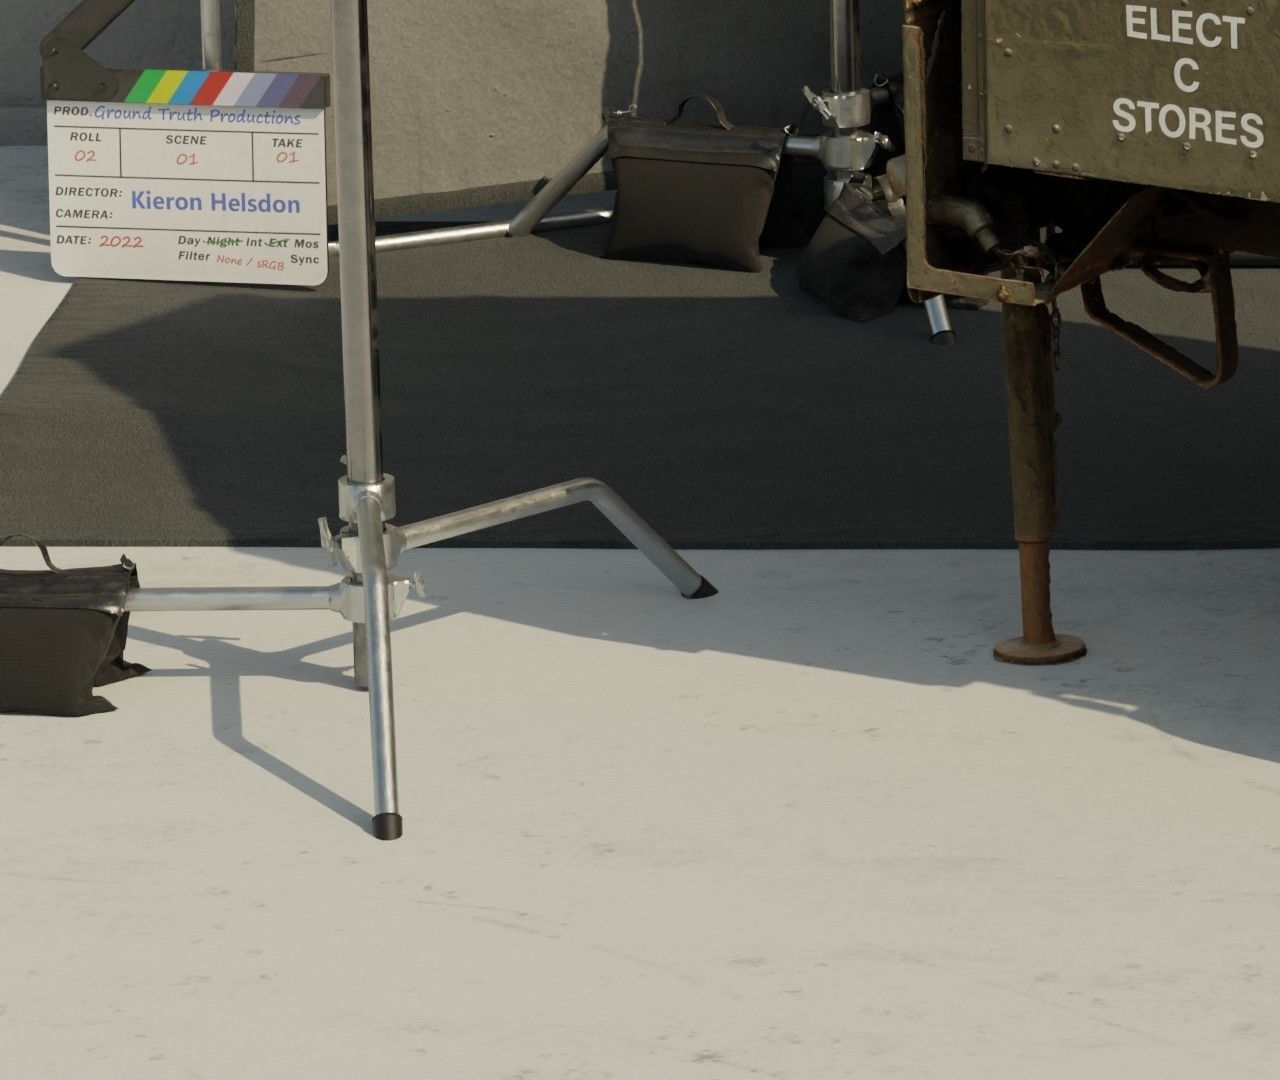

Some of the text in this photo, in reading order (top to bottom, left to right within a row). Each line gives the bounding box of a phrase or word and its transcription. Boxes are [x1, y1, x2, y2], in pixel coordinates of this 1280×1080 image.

[1125, 4, 1246, 50] ELECT
[1173, 57, 1200, 93] C
[53, 105, 301, 126] PROD. Ground Truth Productions
[1112, 97, 1265, 149] STORES
[70, 132, 102, 143] ROLL
[165, 134, 207, 146] SCENE
[272, 137, 303, 149] TAKE
[74, 149, 97, 163] 02
[176, 153, 199, 166] 01
[276, 151, 299, 164] 01
[55, 186, 123, 198] DIRECTOR:
[131, 190, 301, 214] Kieron Helsdon
[55, 208, 113, 220] CAMERA:
[56, 235, 145, 249] DATE: 2022
[178, 235, 201, 247] Day
[246, 237, 263, 248] Int
[294, 238, 319, 249] Mos
[178, 250, 211, 261] Filter
[216, 254, 243, 267] None
[256, 259, 285, 272] sRGB
[290, 253, 320, 266] Sync
